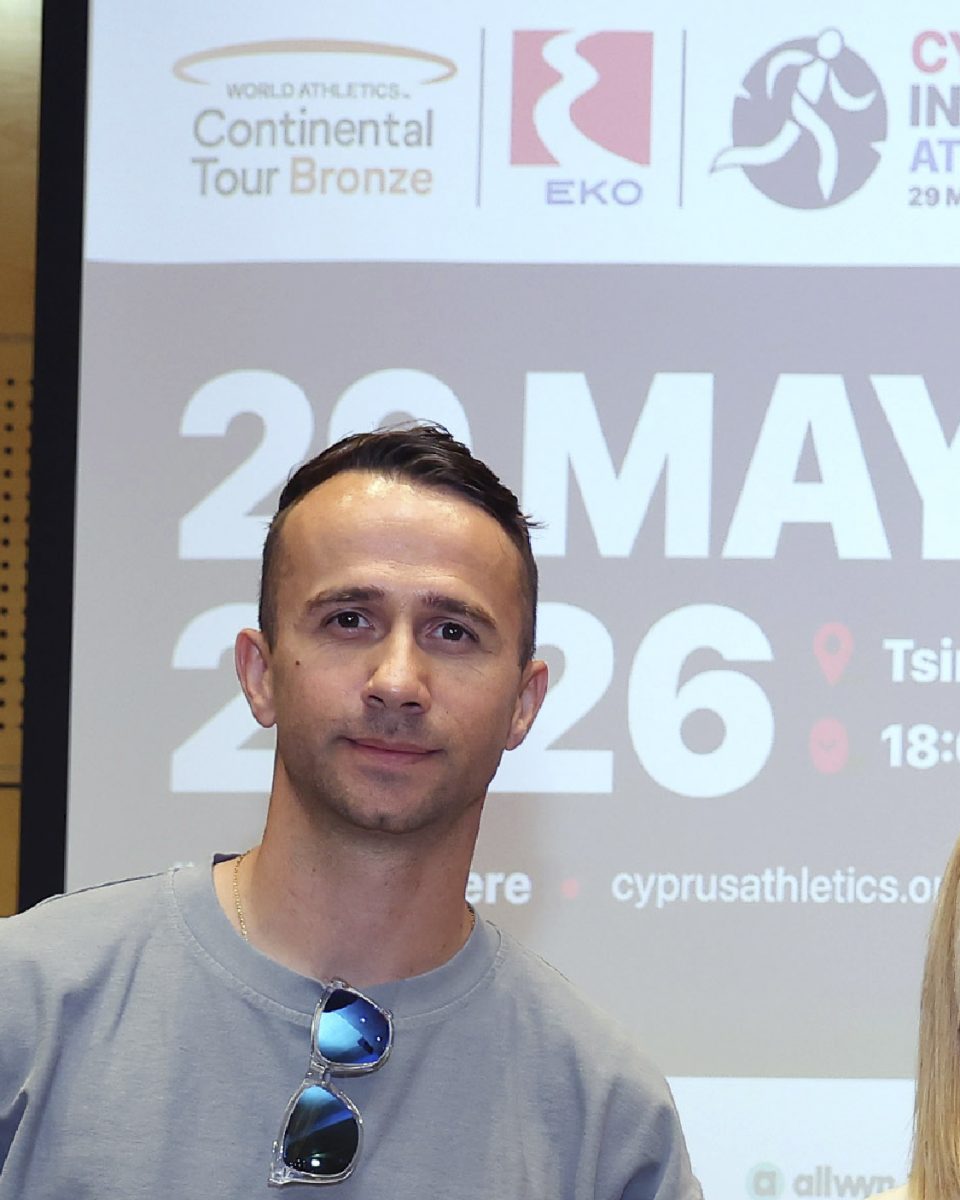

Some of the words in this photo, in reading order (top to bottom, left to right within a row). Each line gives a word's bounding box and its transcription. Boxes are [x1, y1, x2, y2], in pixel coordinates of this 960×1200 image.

[226, 82, 295, 99] WORLD
[300, 82, 401, 99] ATHLETICS
[193, 105, 435, 148] Continental
[191, 156, 280, 197] Tour
[289, 156, 434, 196] Bronze
[545, 179, 644, 206] EKO
[908, 187, 941, 208] 29
[178, 368, 472, 560] 2
[170, 602, 775, 799] 226
[465, 871, 532, 905] ere
[611, 867, 943, 910] cyprusathletics.o
